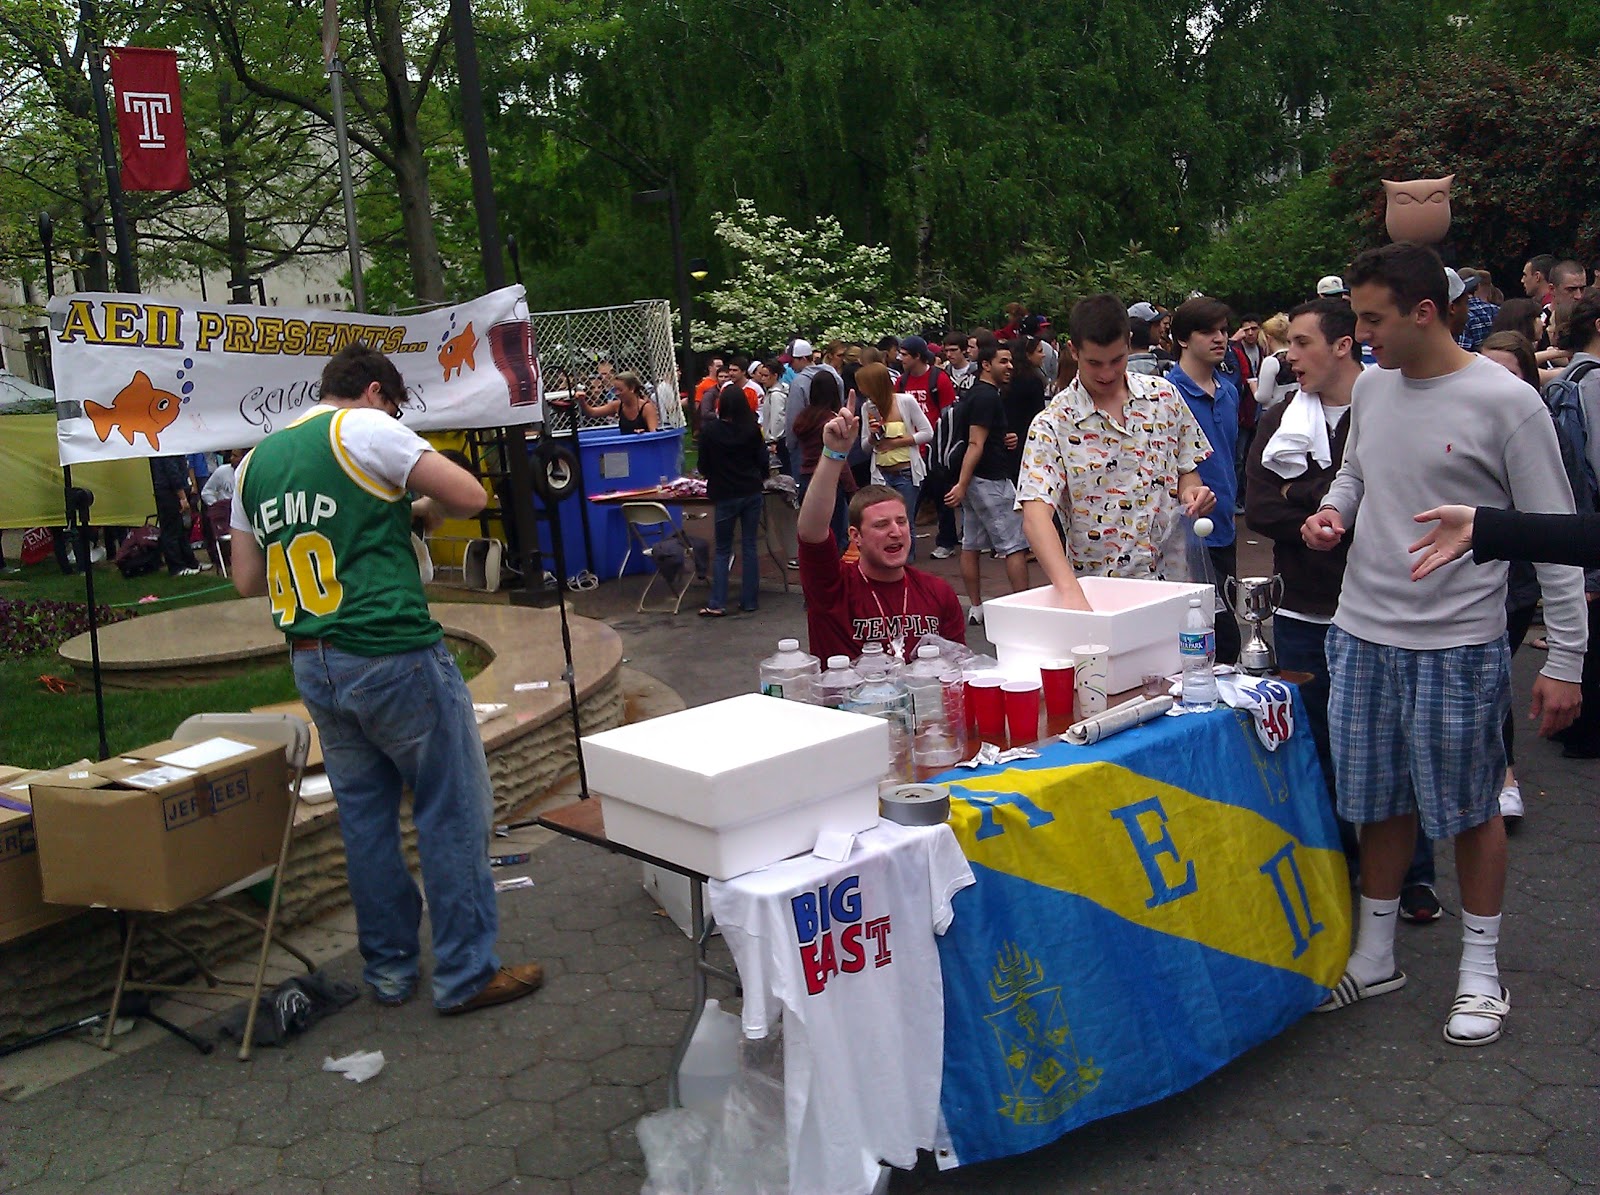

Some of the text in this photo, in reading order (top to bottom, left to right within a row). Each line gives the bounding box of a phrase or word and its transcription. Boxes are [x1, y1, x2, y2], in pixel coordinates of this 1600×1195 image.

[123, 91, 172, 149] T
[306, 292, 351, 304] LIBRA
[252, 491, 337, 549] KEMP
[266, 531, 344, 626] 40
[853, 615, 939, 640] TEMPLE
[169, 780, 247, 821] JEREES
[791, 876, 862, 944] BIG
[800, 915, 892, 996] EAST
